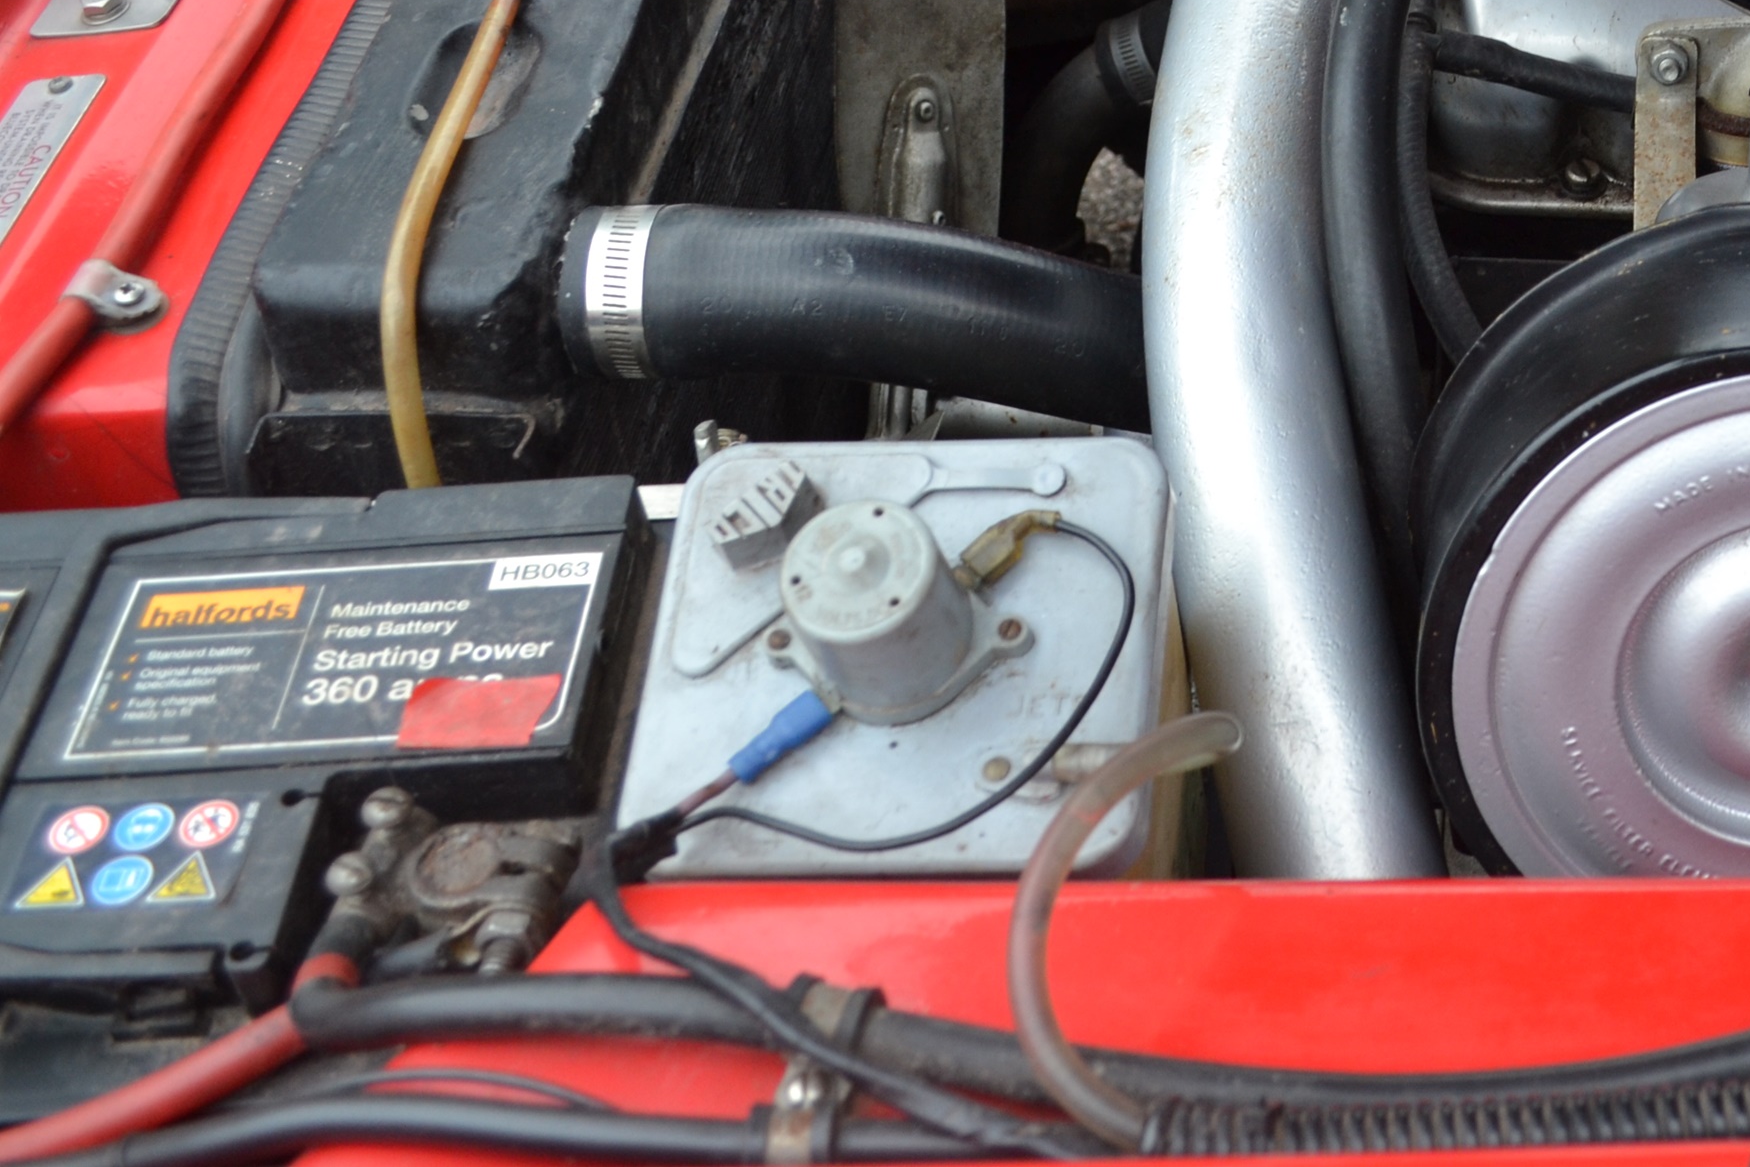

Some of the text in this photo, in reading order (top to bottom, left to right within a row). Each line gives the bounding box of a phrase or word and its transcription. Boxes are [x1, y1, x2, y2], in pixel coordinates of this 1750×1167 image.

[1653, 474, 1714, 514] MADE
[1726, 464, 1750, 483] IN
[500, 560, 591, 582] HB063
[149, 600, 292, 627] halfords
[330, 597, 471, 619] Maintenance
[322, 618, 459, 640] Free Battery
[146, 645, 255, 662] Standard battery
[313, 639, 555, 672] Starting Power
[140, 661, 261, 681] Original equipment
[133, 676, 217, 693] specification
[301, 674, 380, 707] 360
[121, 708, 159, 722] ready
[162, 707, 177, 718] to
[127, 697, 159, 711] Fully
[1602, 807, 1653, 856] FILTER
